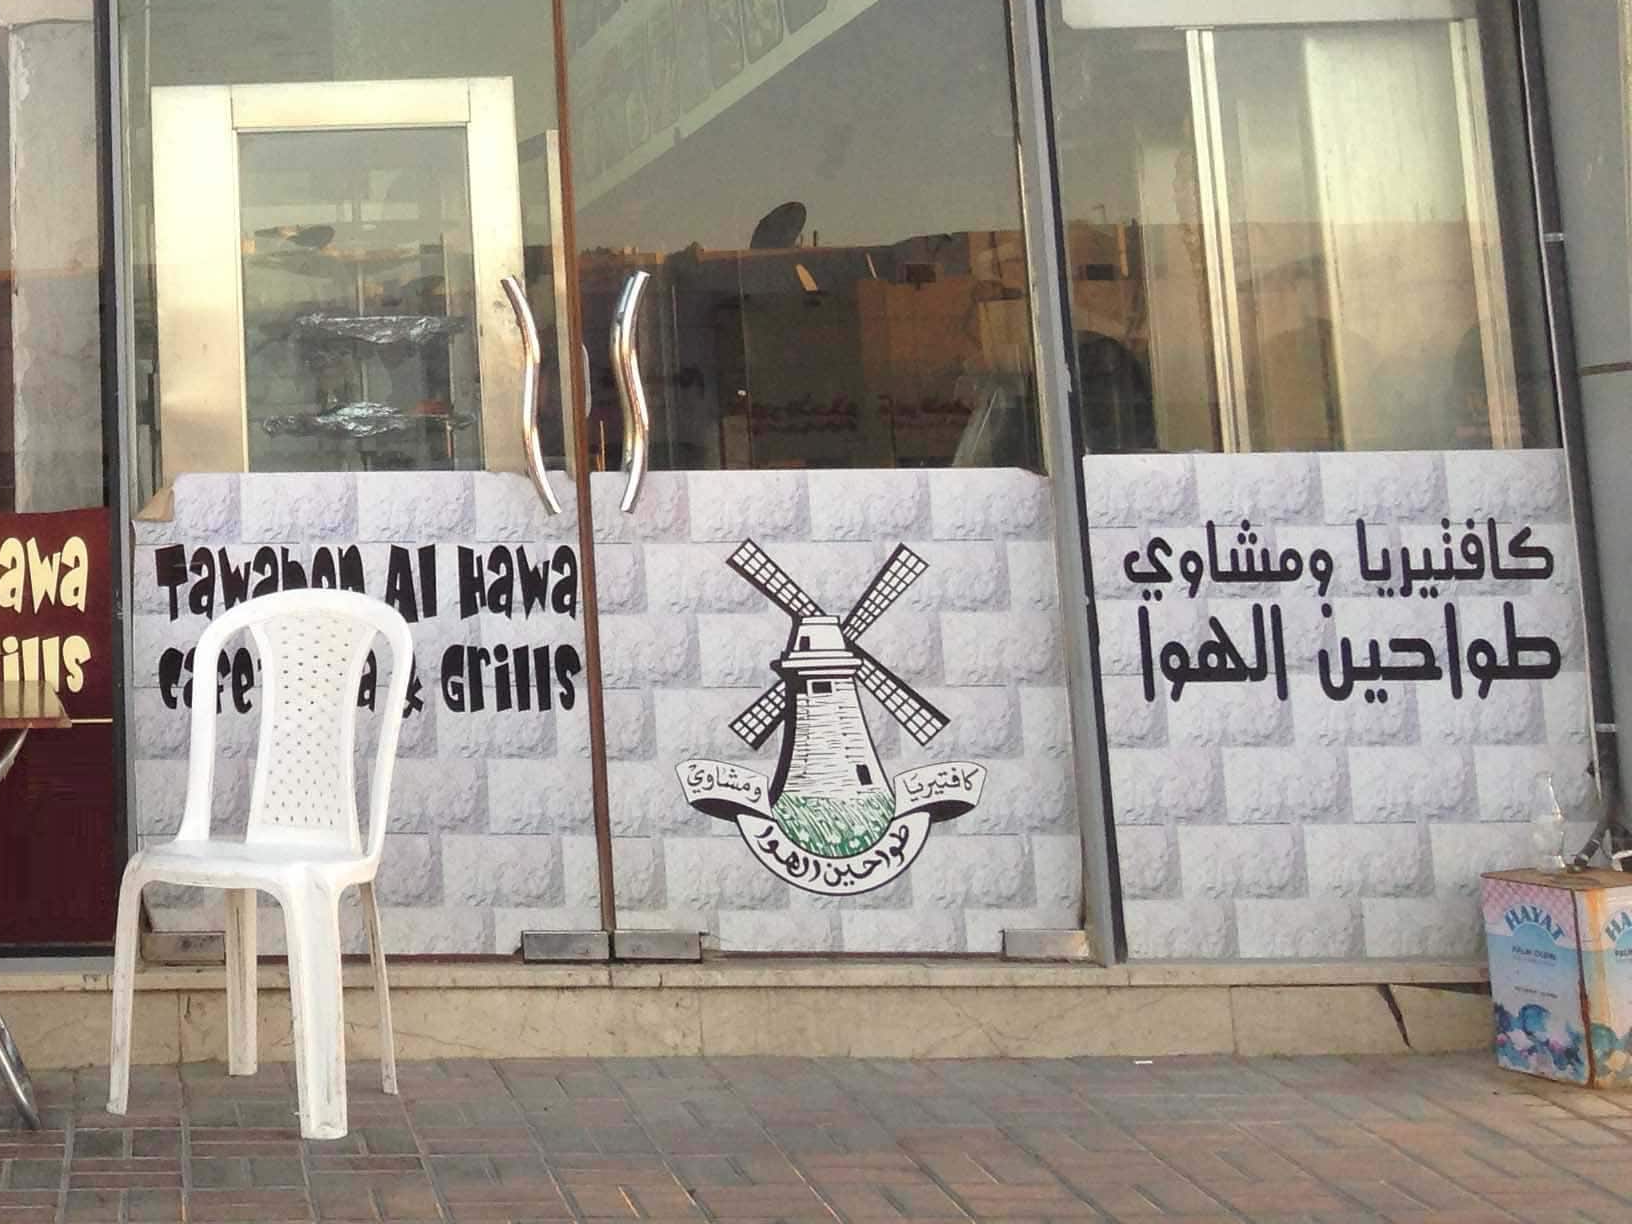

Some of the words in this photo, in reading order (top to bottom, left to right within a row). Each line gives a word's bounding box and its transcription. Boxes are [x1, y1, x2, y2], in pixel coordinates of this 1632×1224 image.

[385, 543, 437, 623] Al
[457, 544, 578, 620] Hawa
[1123, 519, 1334, 601] ومشاوي
[1357, 518, 1555, 598] كافتيريا
[441, 644, 582, 713] Grills
[1138, 603, 1288, 702] الهوا
[1318, 601, 1561, 703] طواحين
[755, 825, 821, 882] الهوا
[823, 824, 909, 887] طواحين
[1504, 905, 1565, 941] HAYAT
